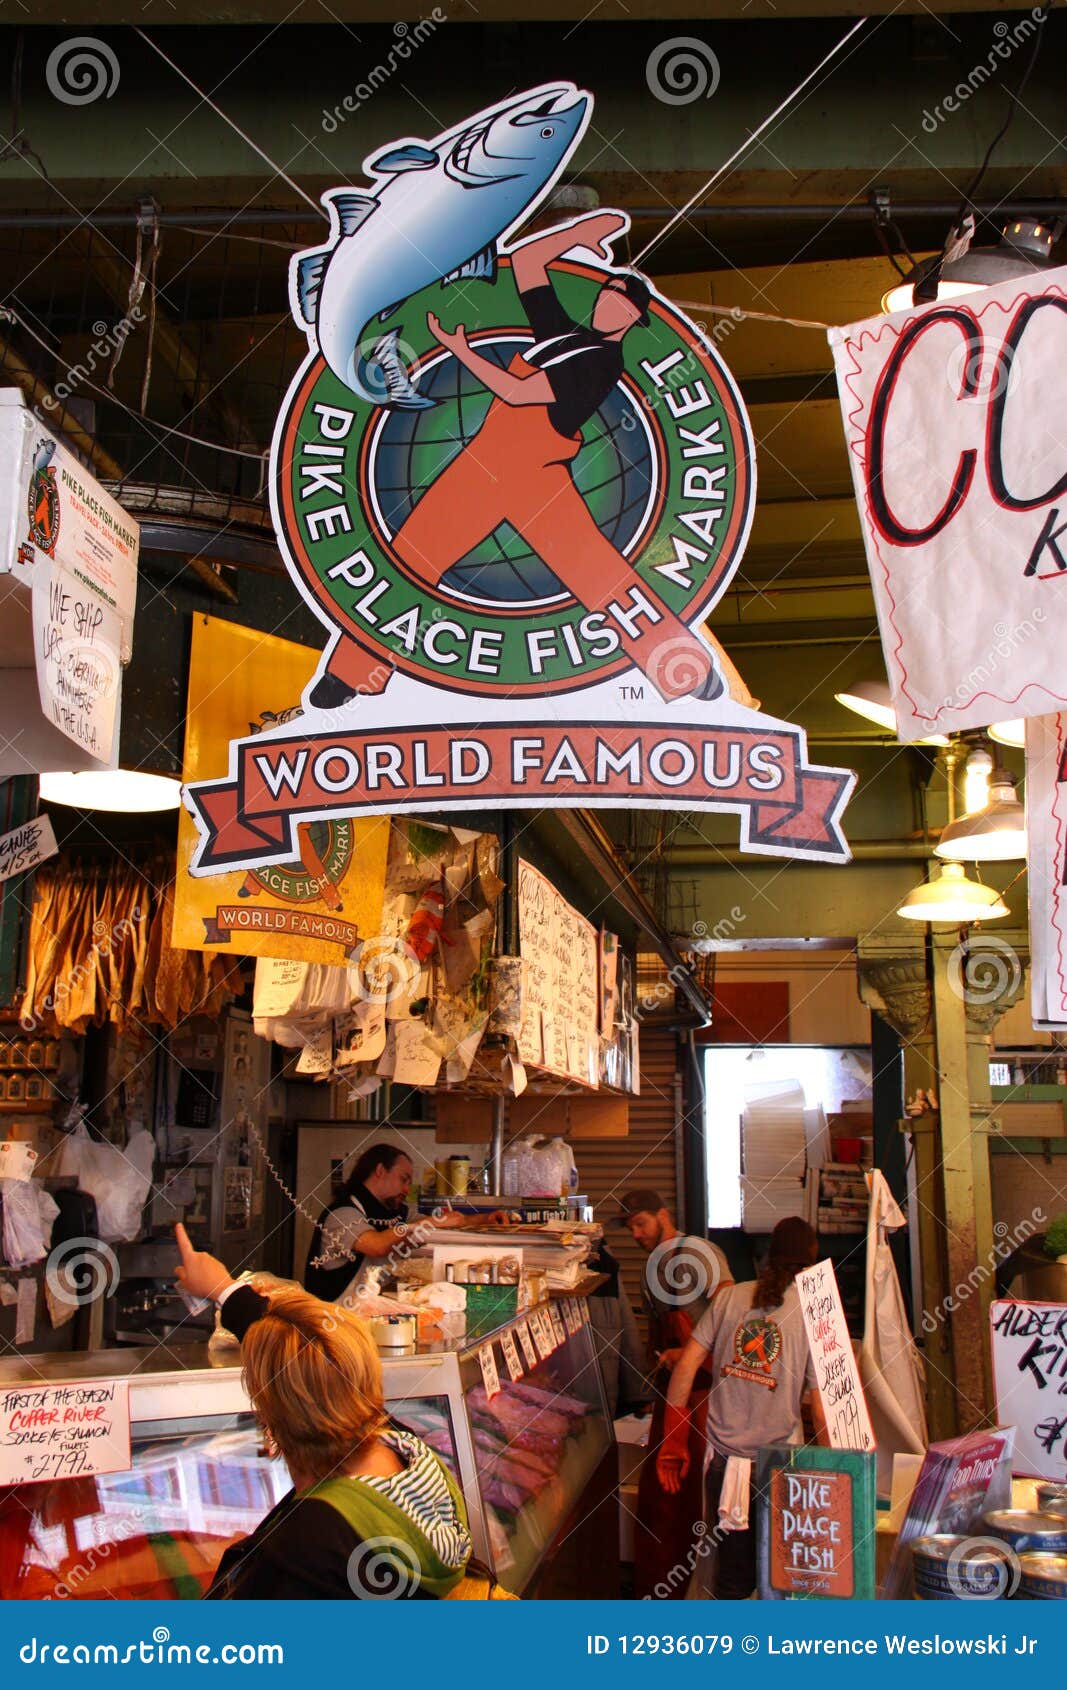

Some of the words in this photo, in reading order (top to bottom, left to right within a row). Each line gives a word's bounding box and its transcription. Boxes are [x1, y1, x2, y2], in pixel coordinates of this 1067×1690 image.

[300, 402, 355, 543] PIKE
[650, 348, 728, 591] MARKET
[61, 469, 78, 494] PIKE
[77, 487, 99, 515] PLACE
[99, 506, 114, 529] FISH
[113, 523, 137, 552] MARKET
[50, 581, 71, 625] WE
[326, 548, 504, 676] PLACE
[525, 584, 664, 675] FISH
[619, 686, 644, 700] TM
[254, 738, 493, 800] WORLD
[511, 735, 785, 790] FAMOUS
[295, 874, 330, 897] FISH
[330, 819, 349, 876] MARK
[221, 910, 287, 929] WORLD
[290, 916, 355, 943] FAMOUS
[526, 1209, 543, 1223] got
[543, 1208, 567, 1222] fish?
[51, 1387, 76, 1405] THE
[76, 1382, 115, 1404] SEASON
[63, 1405, 111, 1424] RIVER
[2, 1428, 65, 1446] SOCKEYE
[66, 1422, 113, 1441] SALMON
[788, 1476, 831, 1510] PIKE
[782, 1509, 841, 1543] PLACE
[791, 1541, 834, 1570] FISH
